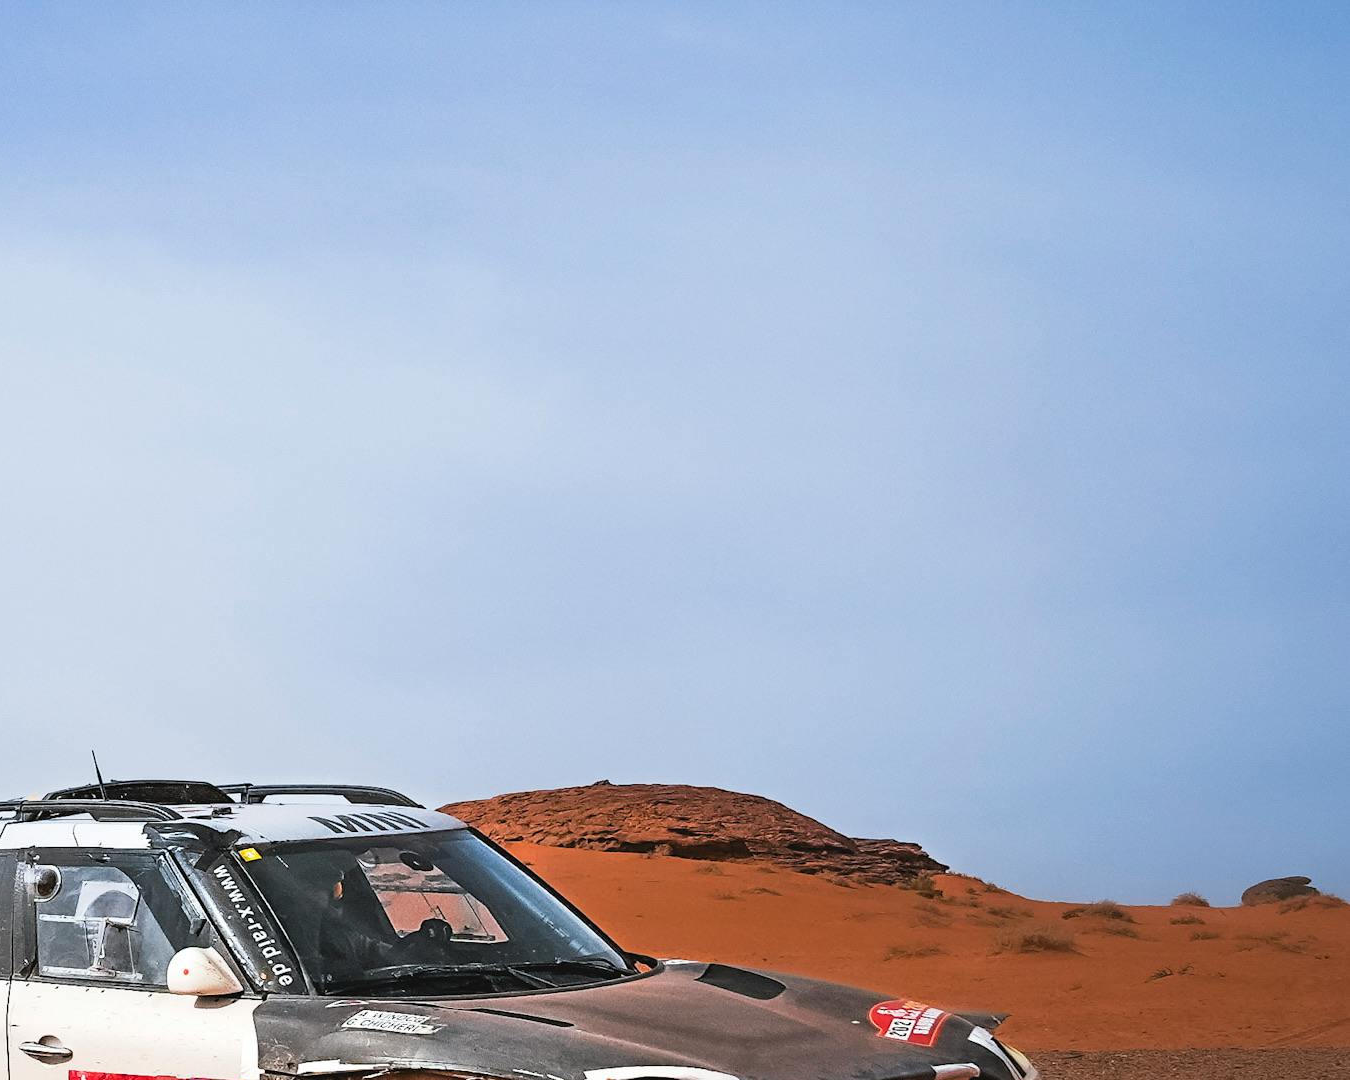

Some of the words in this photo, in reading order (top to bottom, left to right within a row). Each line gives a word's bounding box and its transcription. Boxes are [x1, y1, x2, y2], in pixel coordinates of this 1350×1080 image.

[307, 811, 430, 833] MINI
[213, 864, 293, 986] www.x-raid.de
[889, 1021, 912, 1037] 202
